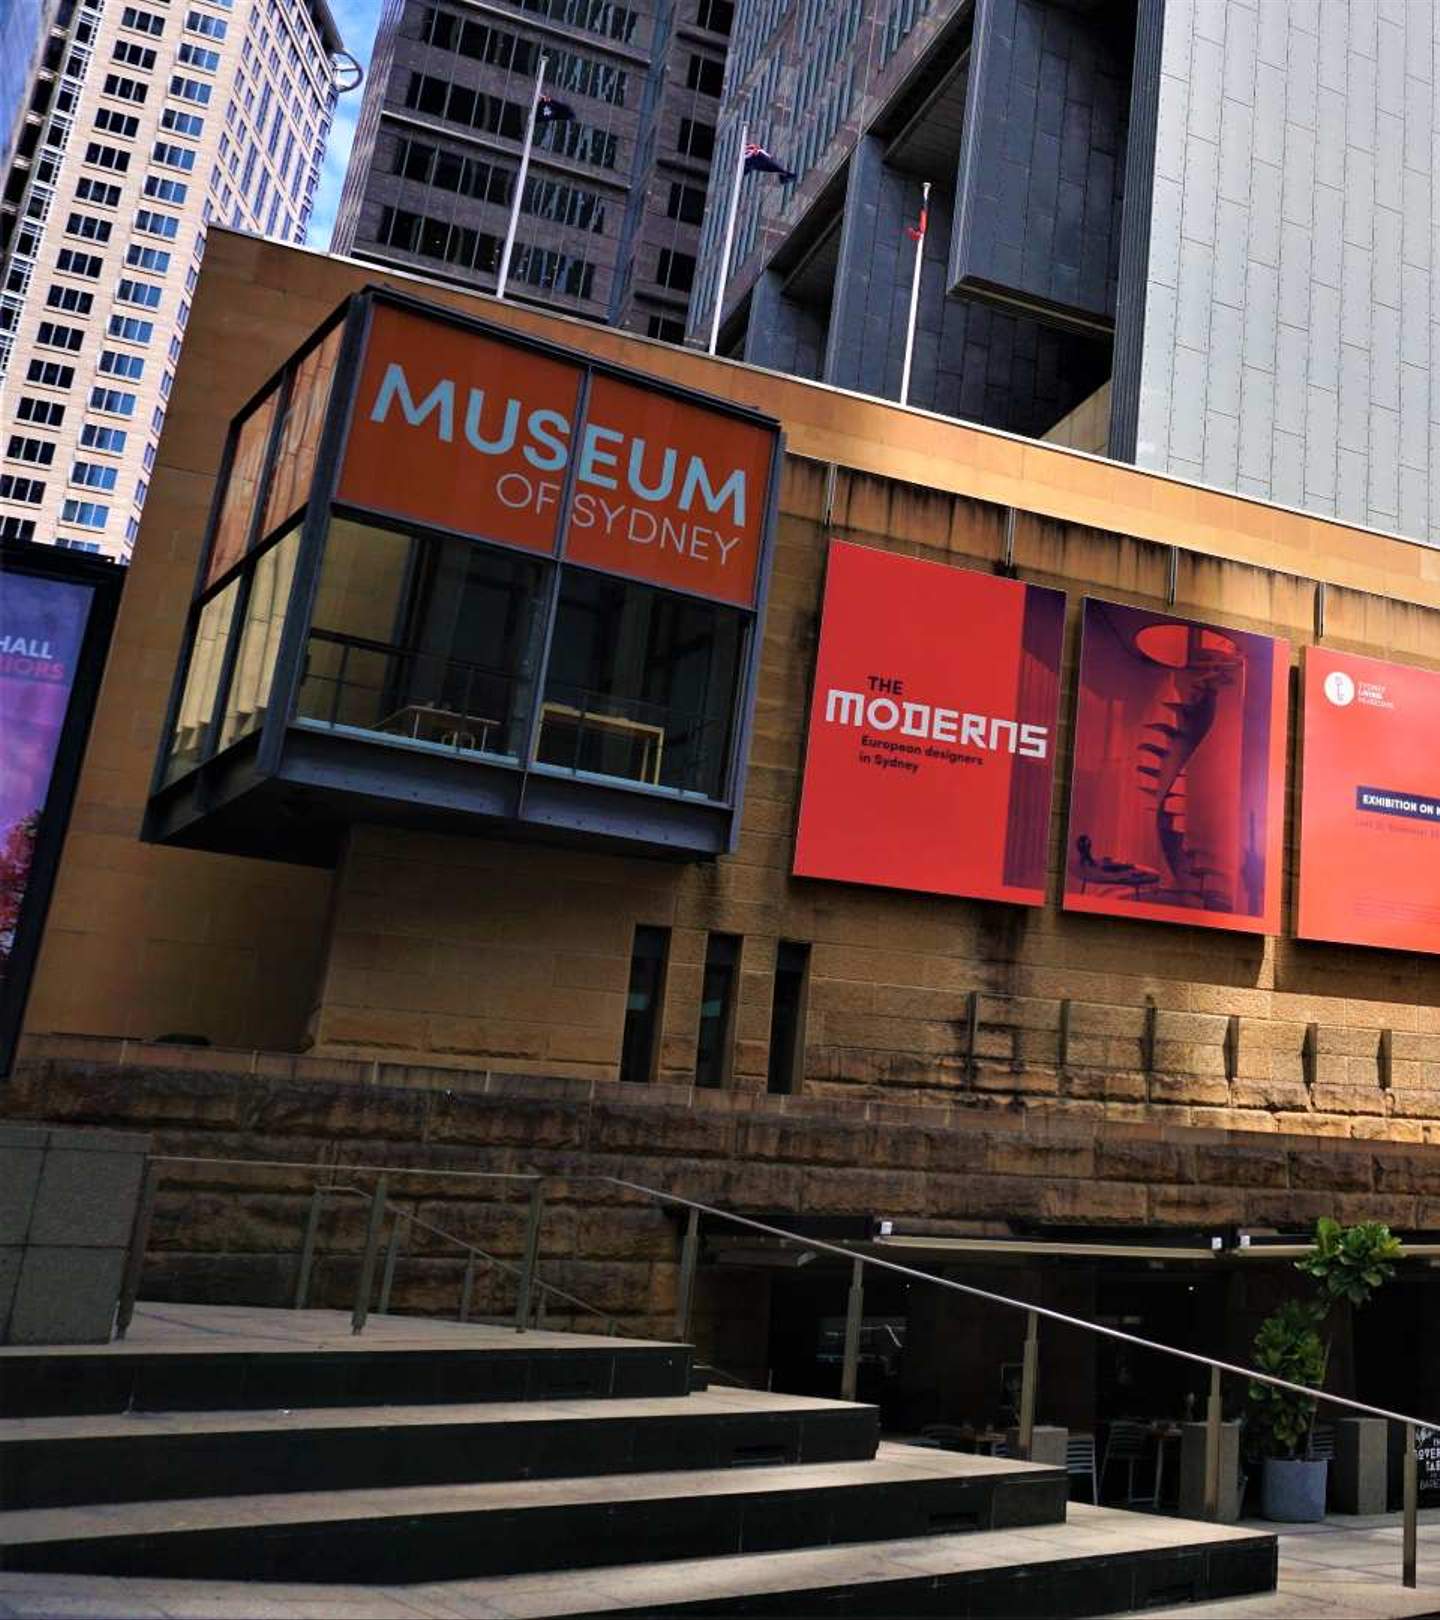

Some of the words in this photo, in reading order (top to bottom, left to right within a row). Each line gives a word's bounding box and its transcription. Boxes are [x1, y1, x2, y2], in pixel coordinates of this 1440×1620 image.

[369, 362, 746, 528] MUSEUM
[496, 473, 561, 515] OF
[571, 493, 741, 566] SYDNEY
[867, 675, 904, 696] THE
[825, 688, 1049, 759] MODERNS
[858, 752, 872, 764] in
[873, 753, 919, 774] Sydney
[861, 735, 923, 757] European
[924, 744, 985, 766] designers
[1362, 794, 1417, 812] EXHIBITION
[1419, 803, 1434, 815] ON
